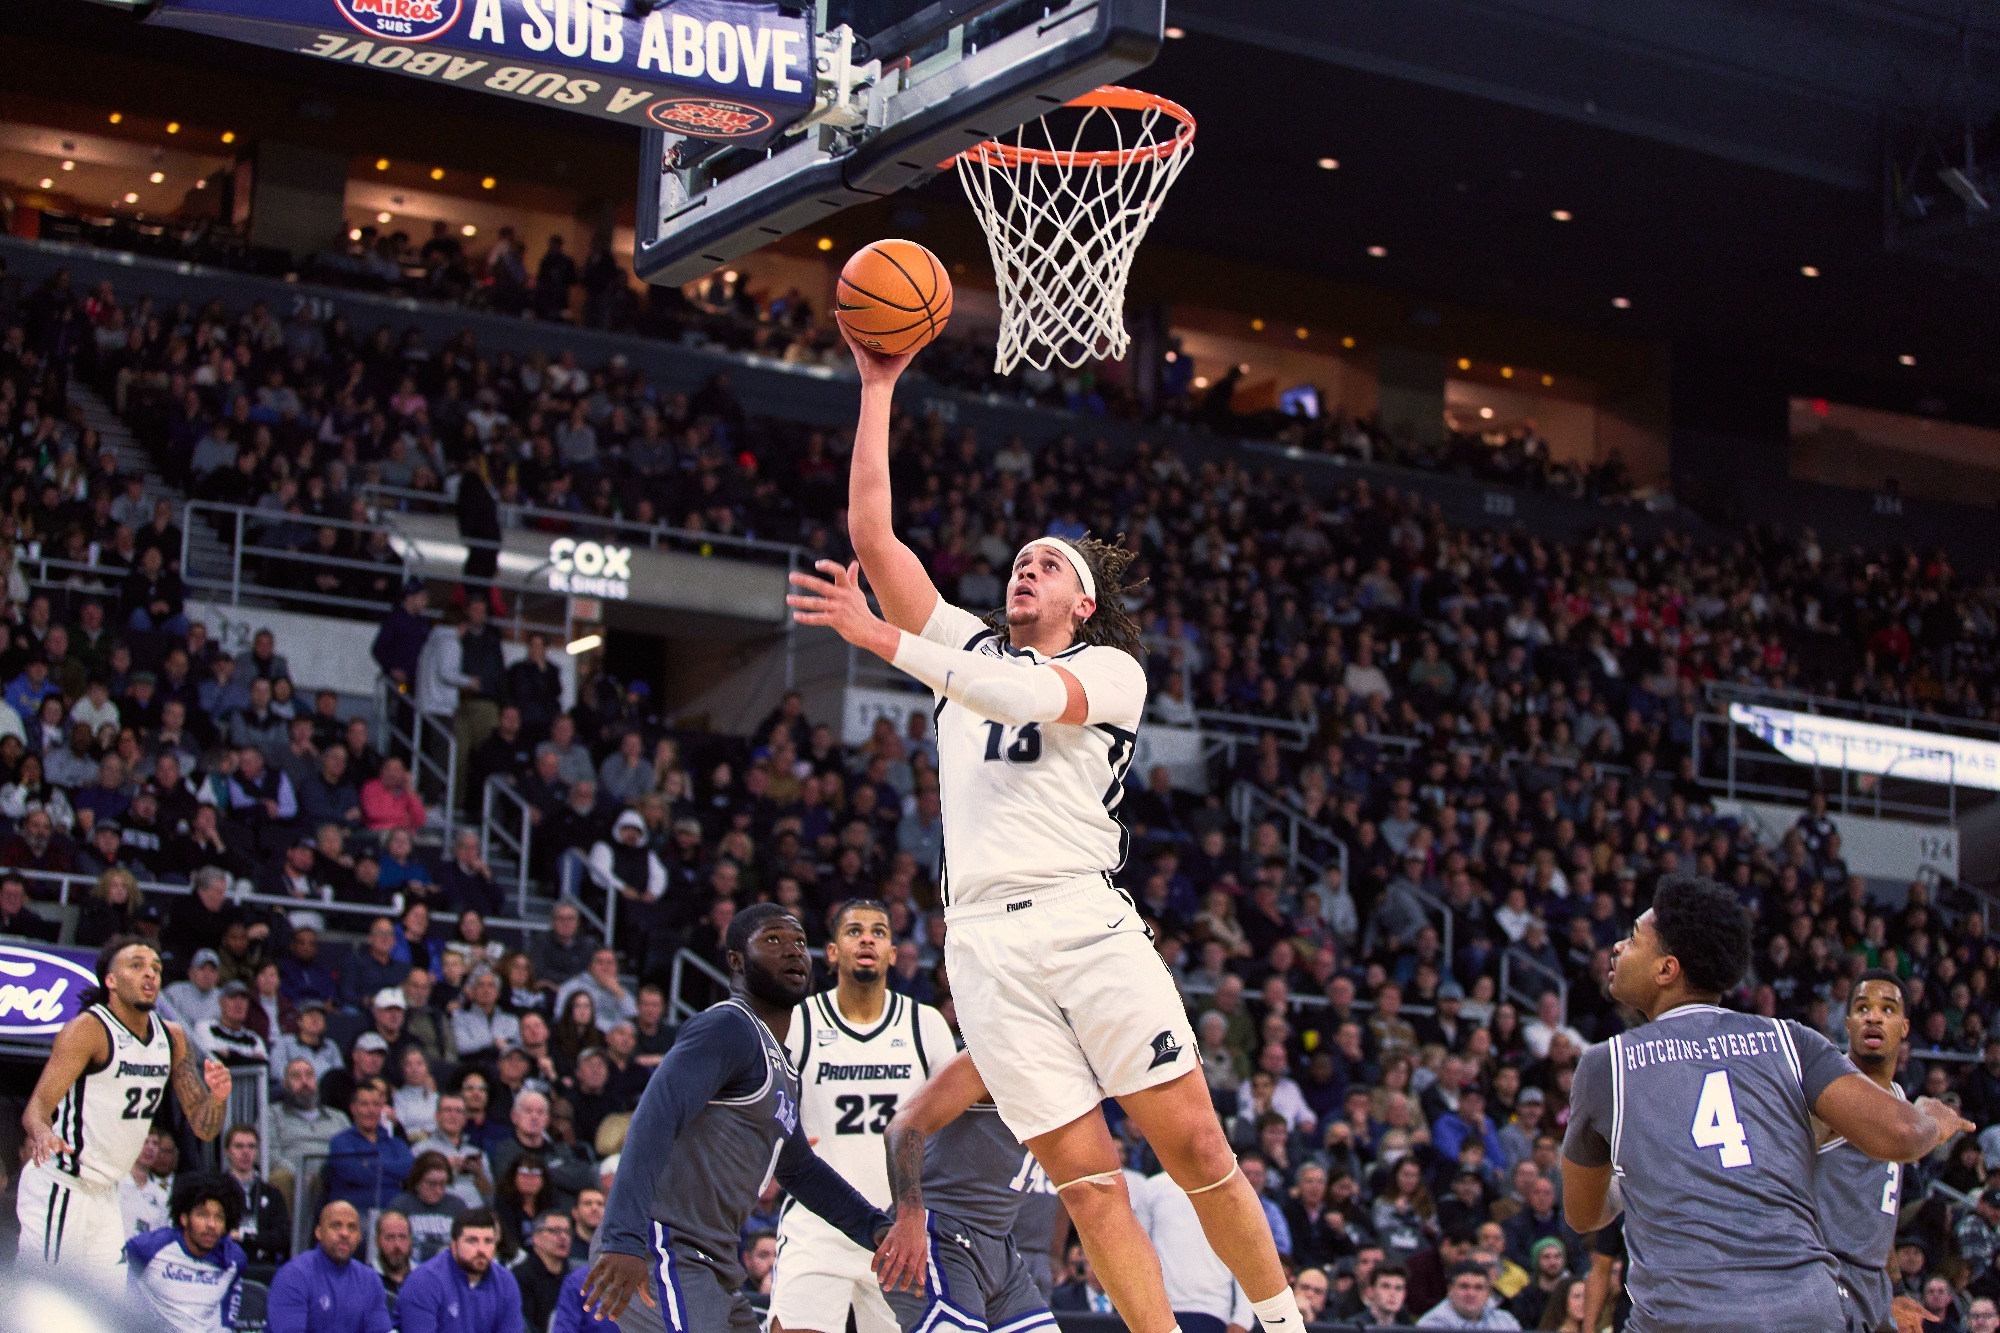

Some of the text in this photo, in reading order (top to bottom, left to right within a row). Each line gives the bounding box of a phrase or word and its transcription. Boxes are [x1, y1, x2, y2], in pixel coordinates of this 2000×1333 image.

[377, 18, 412, 34] SUBS
[469, 0, 802, 93] A SUB ABOVE
[300, 34, 654, 114] A SUB ABOVE
[549, 537, 631, 580] COX
[1921, 836, 1953, 860] 124
[1006, 899, 1033, 913] FRIARS
[1625, 1031, 1779, 1071] HUTCHINS-EVERETT
[815, 1062, 912, 1085] PROVIDENCE
[121, 1086, 162, 1119] 22
[835, 1094, 899, 1136] 23
[1690, 1068, 1753, 1169] 4
[1881, 1161, 1900, 1216] 2
